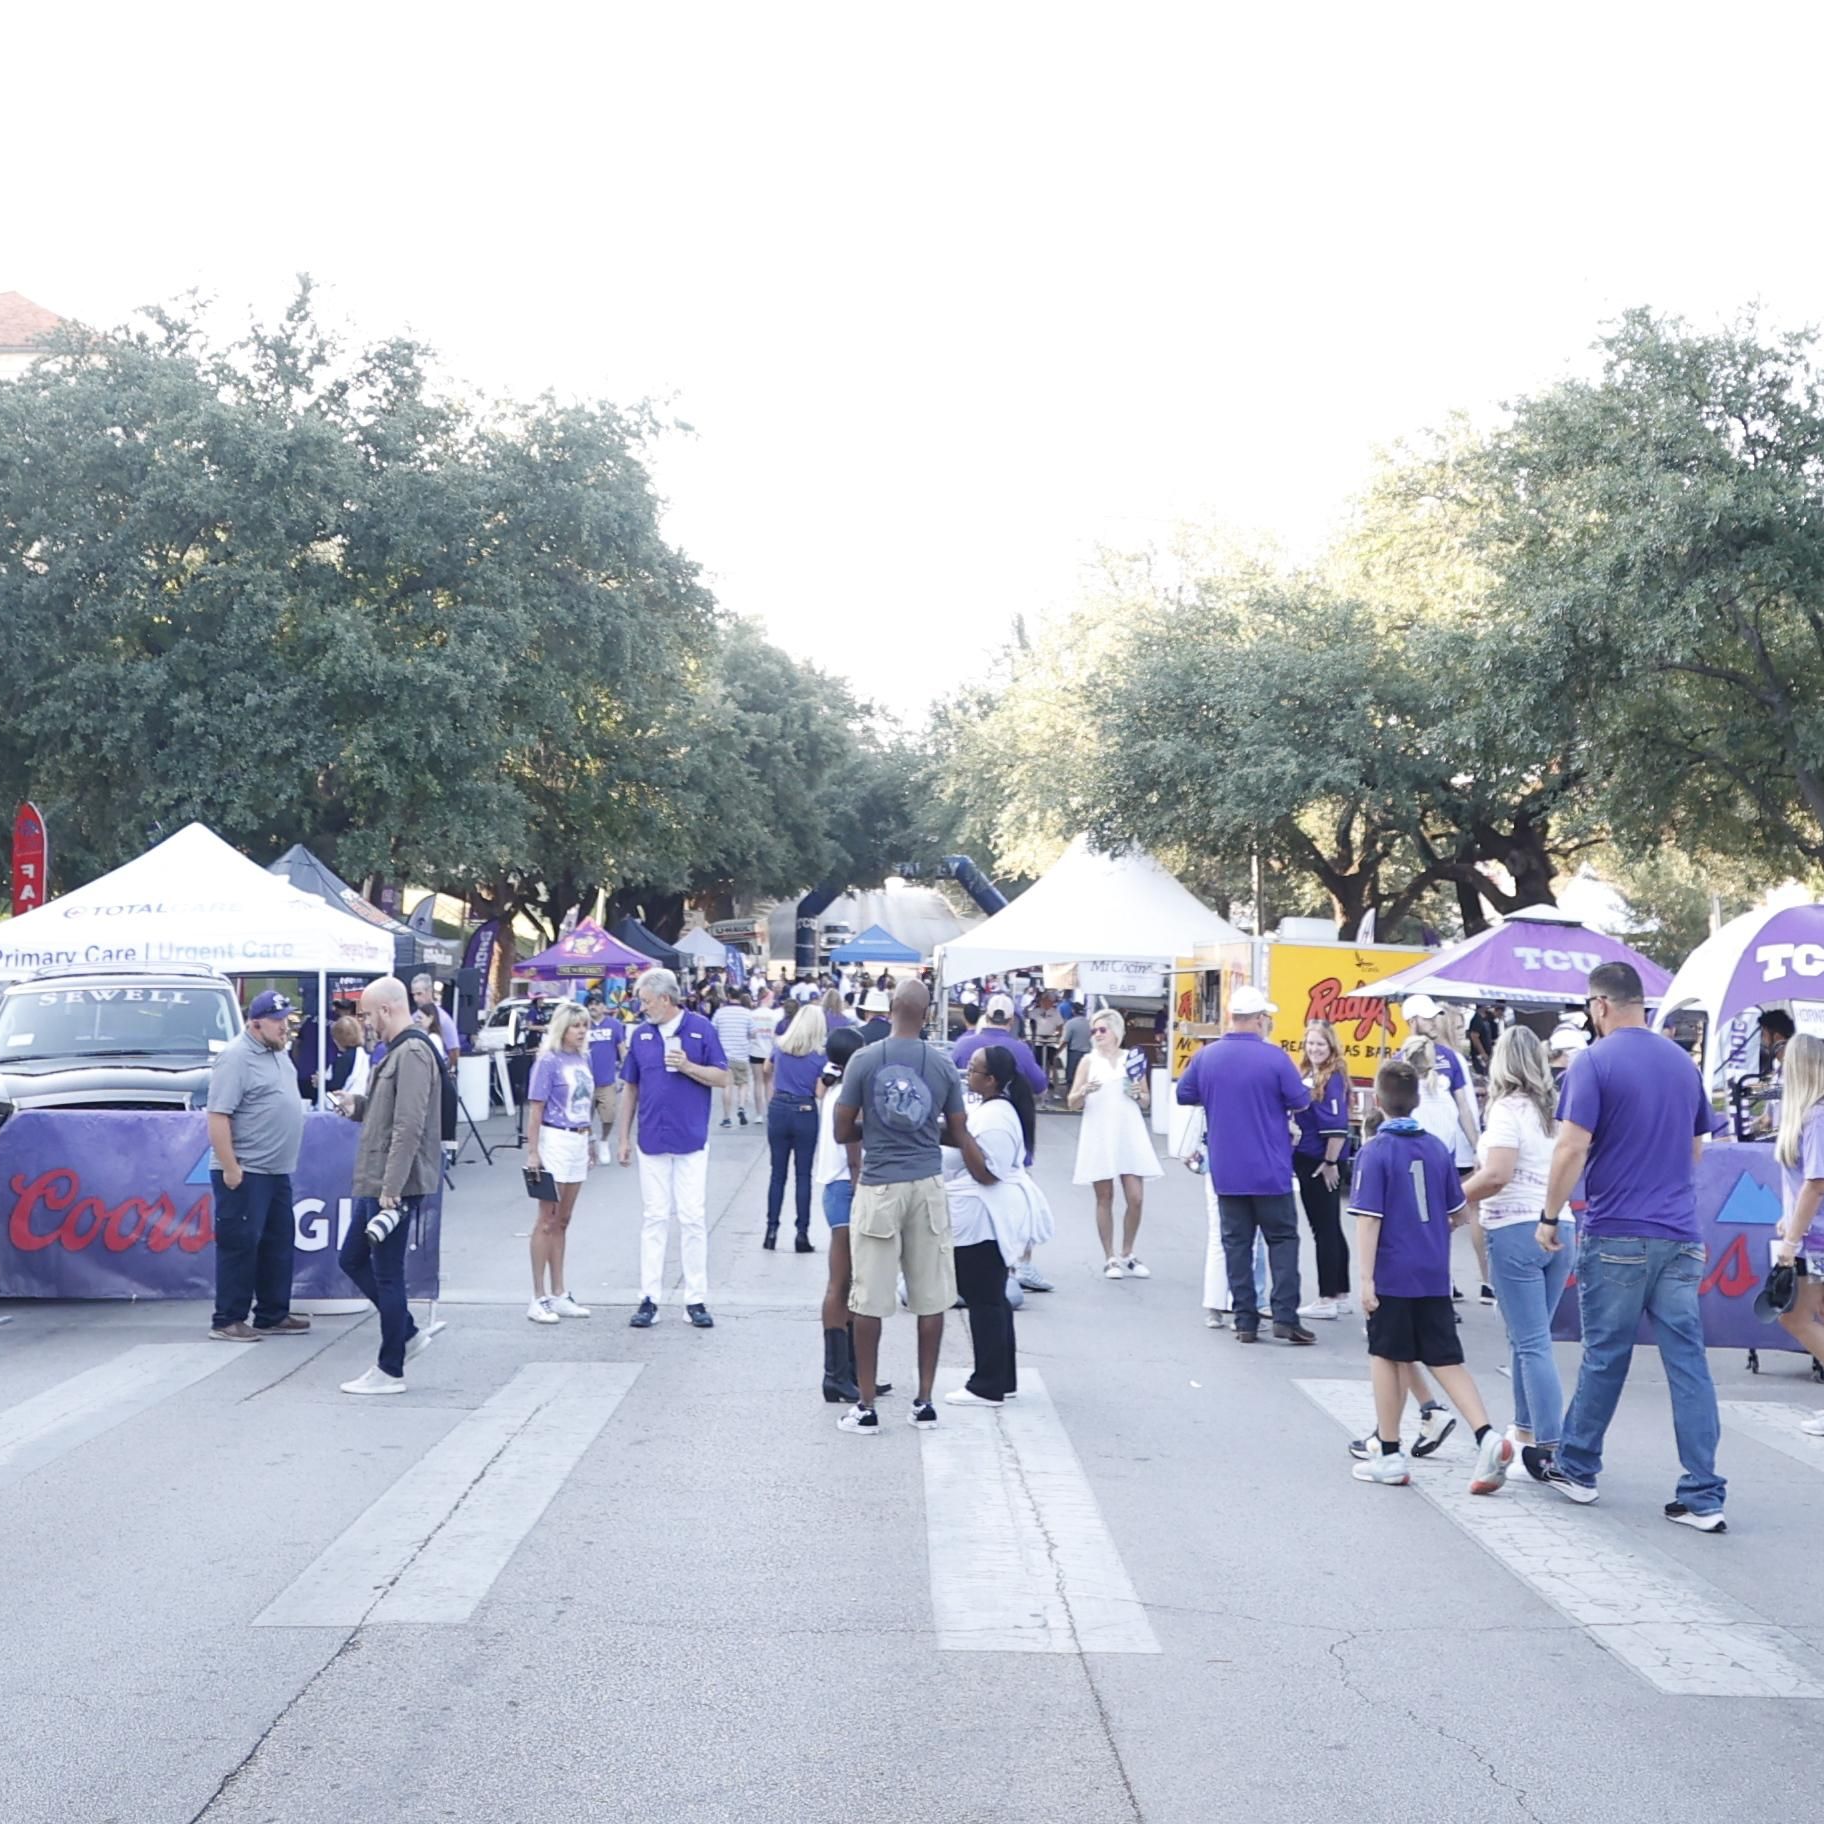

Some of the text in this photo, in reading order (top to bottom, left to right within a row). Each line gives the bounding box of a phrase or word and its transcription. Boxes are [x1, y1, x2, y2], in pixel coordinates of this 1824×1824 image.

[84, 945, 136, 963] Care
[159, 943, 234, 964] Urgent
[242, 940, 294, 959] Care
[1513, 946, 1602, 975] TCU
[38, 989, 190, 1007] SEWELL
[1109, 984, 1136, 993] BAR
[1408, 1160, 1429, 1222] 1
[8, 1167, 216, 1254] Coors
